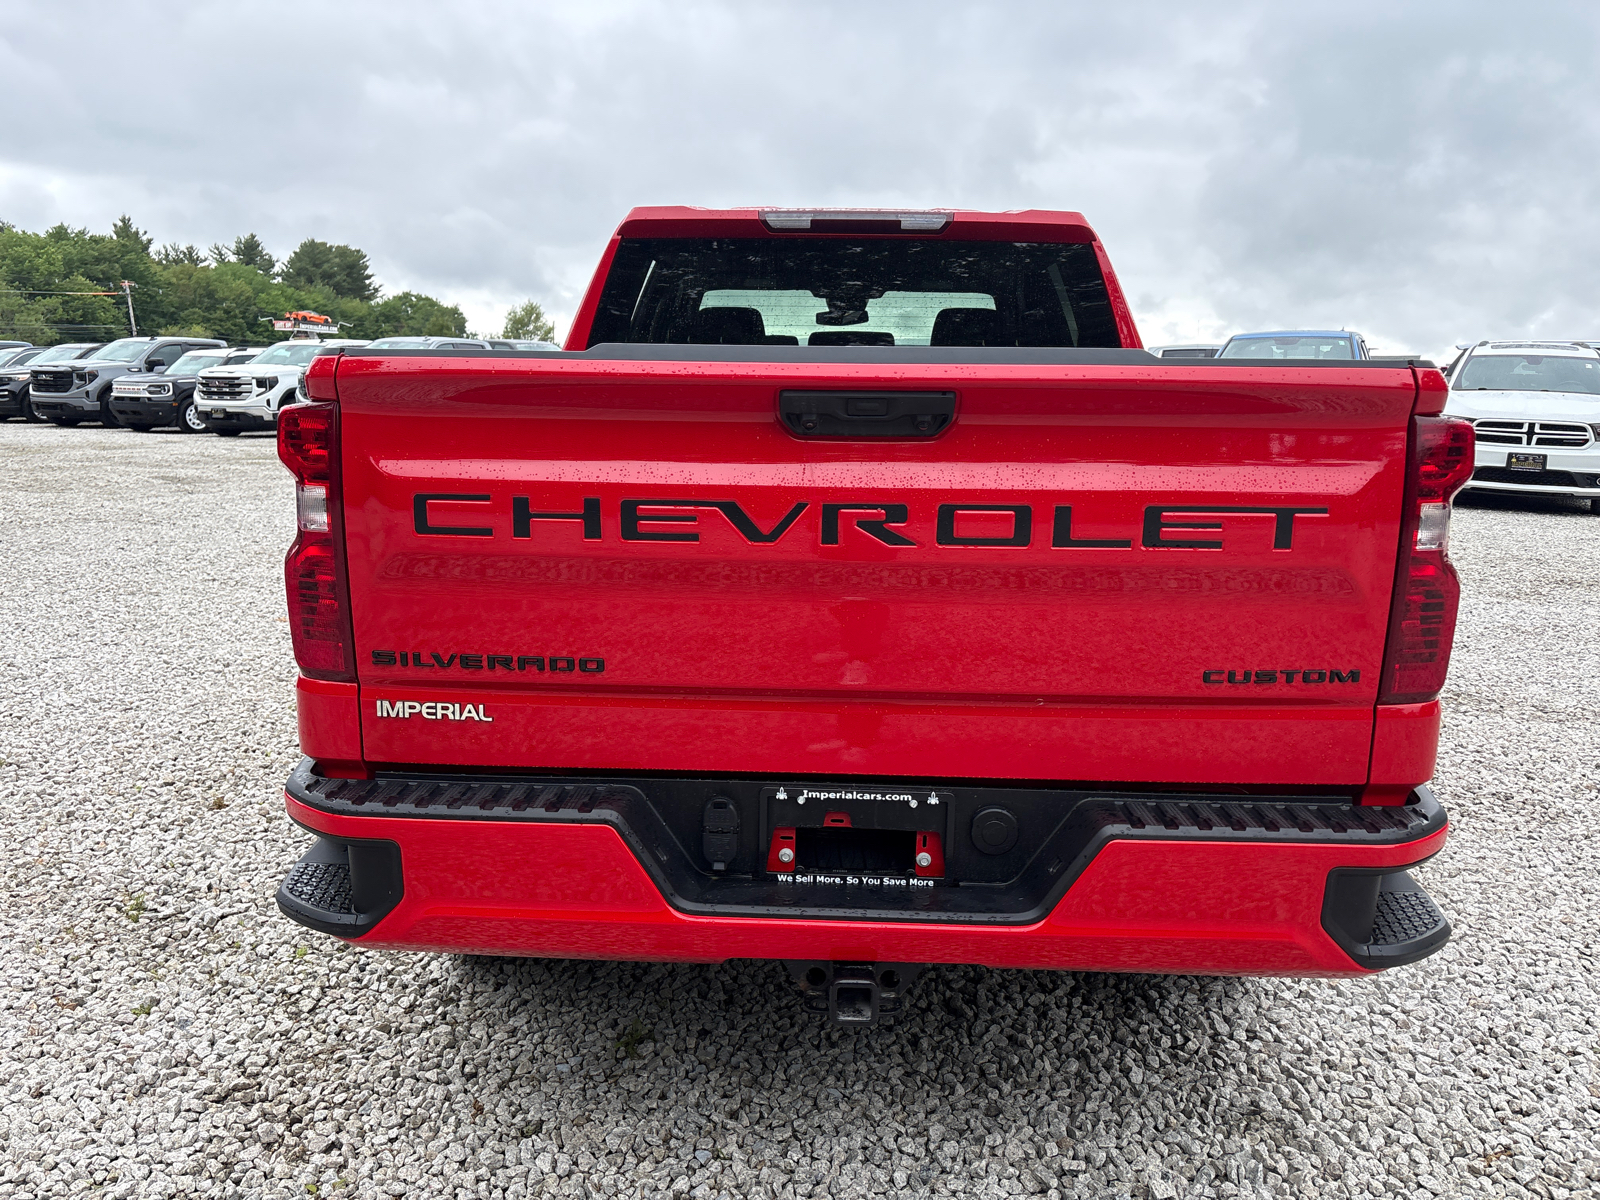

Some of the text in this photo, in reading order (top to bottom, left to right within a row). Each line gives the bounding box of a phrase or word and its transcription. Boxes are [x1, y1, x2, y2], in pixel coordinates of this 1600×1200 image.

[413, 493, 1330, 552] CHEVROLET
[371, 650, 605, 673] SILVERADO
[1202, 669, 1361, 684] CUSTOM
[376, 699, 494, 722] IMPERIAL
[802, 790, 912, 801] Imperialcars.com
[777, 874, 793, 883] We
[795, 874, 814, 883] Sell
[846, 876, 859, 885] So
[862, 876, 880, 886] You
[883, 877, 907, 887] Save
[909, 878, 934, 887] More
